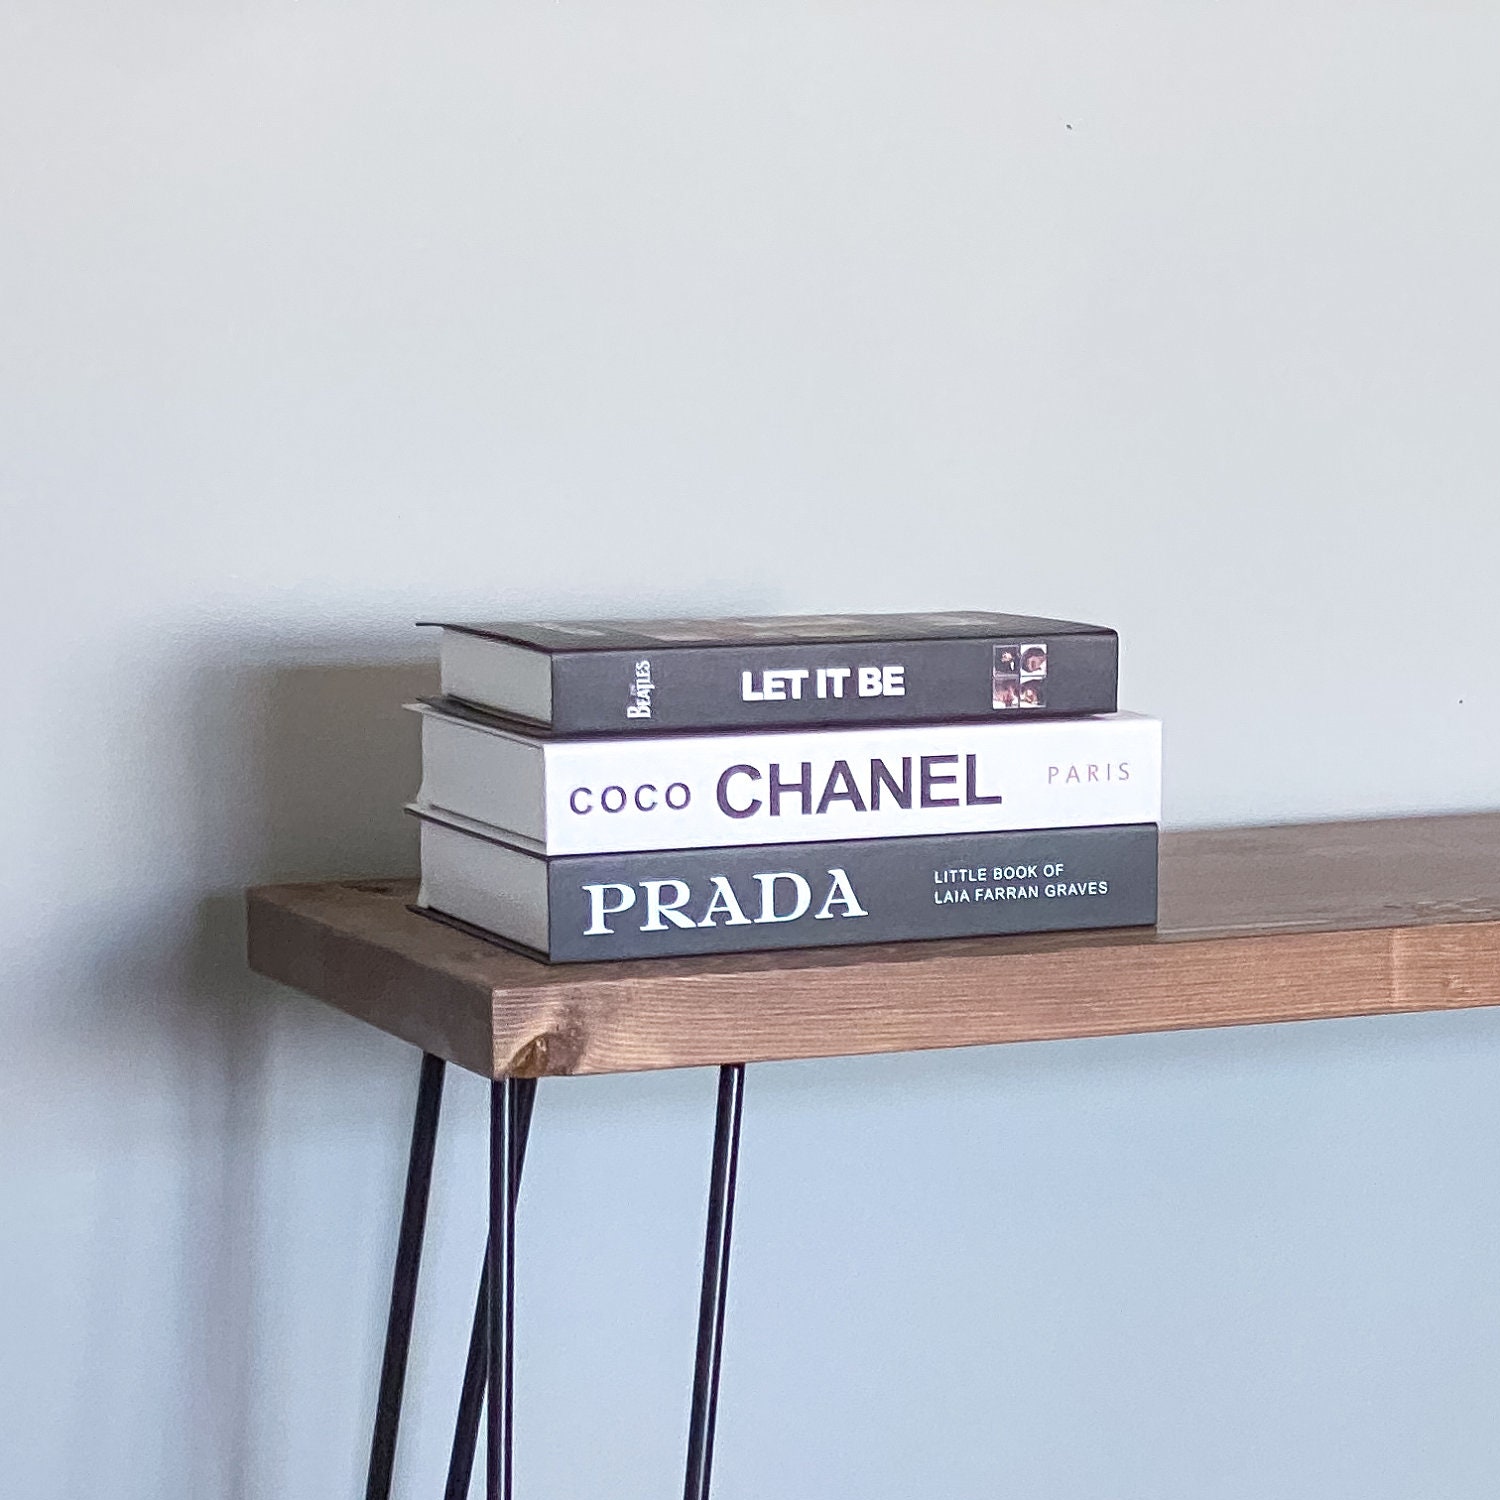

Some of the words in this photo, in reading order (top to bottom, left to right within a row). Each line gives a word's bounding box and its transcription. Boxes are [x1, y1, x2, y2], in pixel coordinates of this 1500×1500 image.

[741, 669, 809, 702] LET
[816, 667, 851, 699] IT
[858, 666, 905, 698] BE
[716, 753, 1002, 819] CHANEL
[1048, 762, 1130, 785] PARIS
[934, 868, 987, 883] LITTLE
[993, 865, 1038, 880] BOOK
[1043, 863, 1064, 878] OF
[582, 868, 868, 936] PRADA
[934, 890, 970, 904] LAIA
[975, 886, 1039, 901] FARRAN
[1044, 881, 1108, 897] GRAVES
